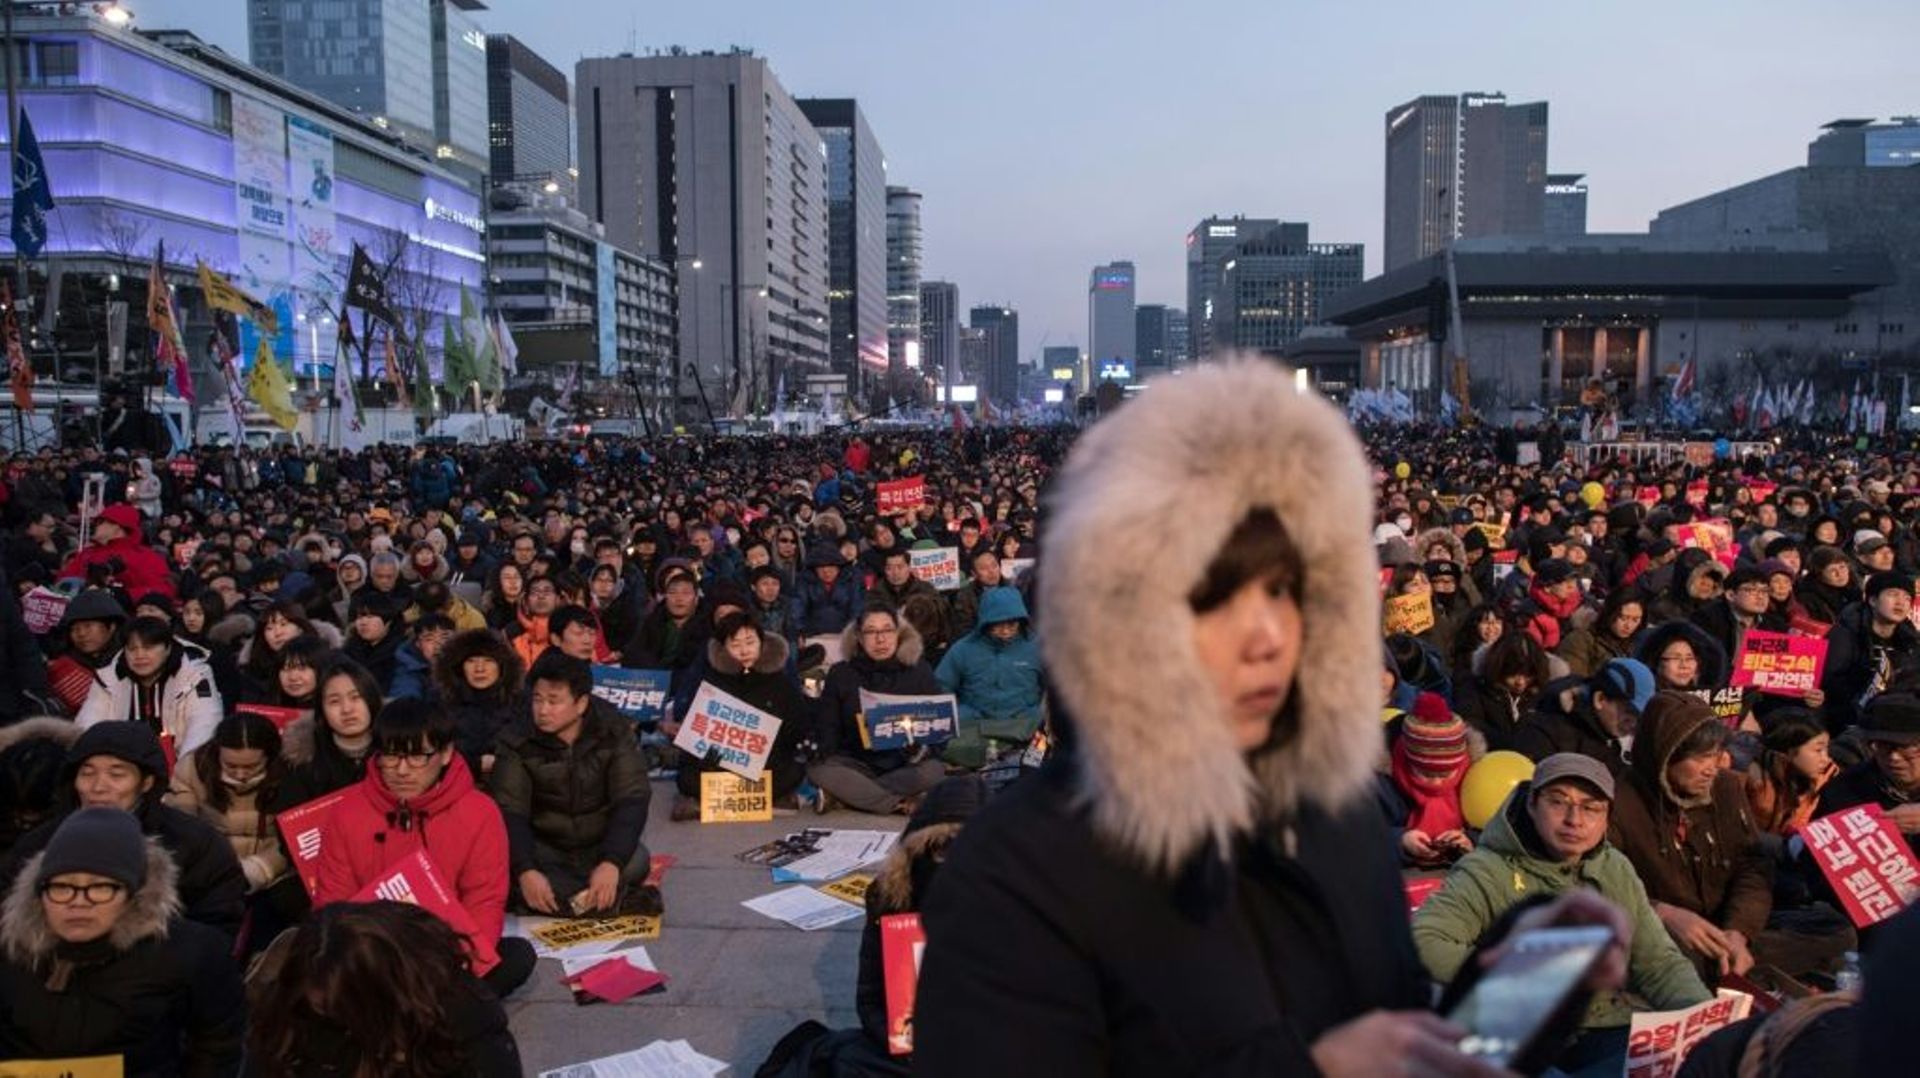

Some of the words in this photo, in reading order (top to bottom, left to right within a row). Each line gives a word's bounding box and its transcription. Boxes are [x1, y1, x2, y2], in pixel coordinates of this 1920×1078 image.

[706, 700, 760, 730] 황교안은
[690, 712, 769, 756] 특검연장
[694, 740, 751, 768] 수하라
[707, 796, 767, 815] 구속하라
[1806, 817, 1859, 872] 즉각
[1842, 867, 1901, 923] 퇴진
[1628, 1021, 1680, 1059] 2월
[1683, 998, 1735, 1041] 탄핵
